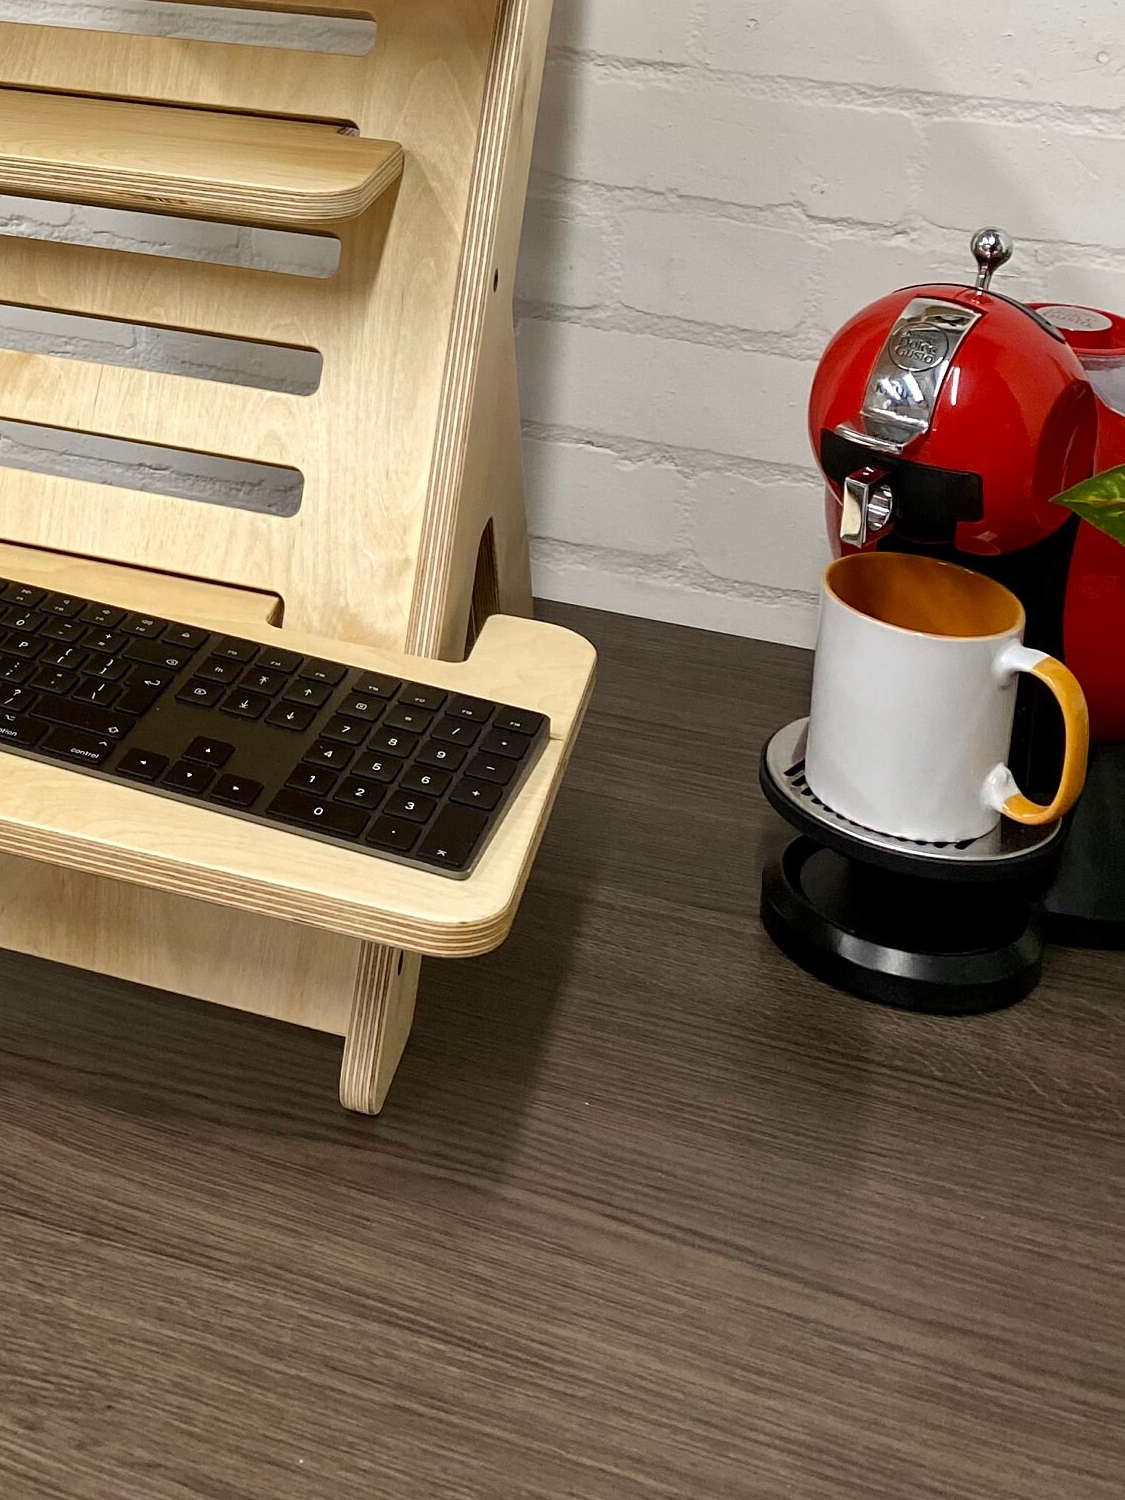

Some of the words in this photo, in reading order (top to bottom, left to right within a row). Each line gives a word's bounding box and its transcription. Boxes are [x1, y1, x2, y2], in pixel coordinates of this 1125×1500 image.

[70, 747, 100, 759] control
[356, 788, 364, 796] 2
[314, 807, 323, 815] 0
